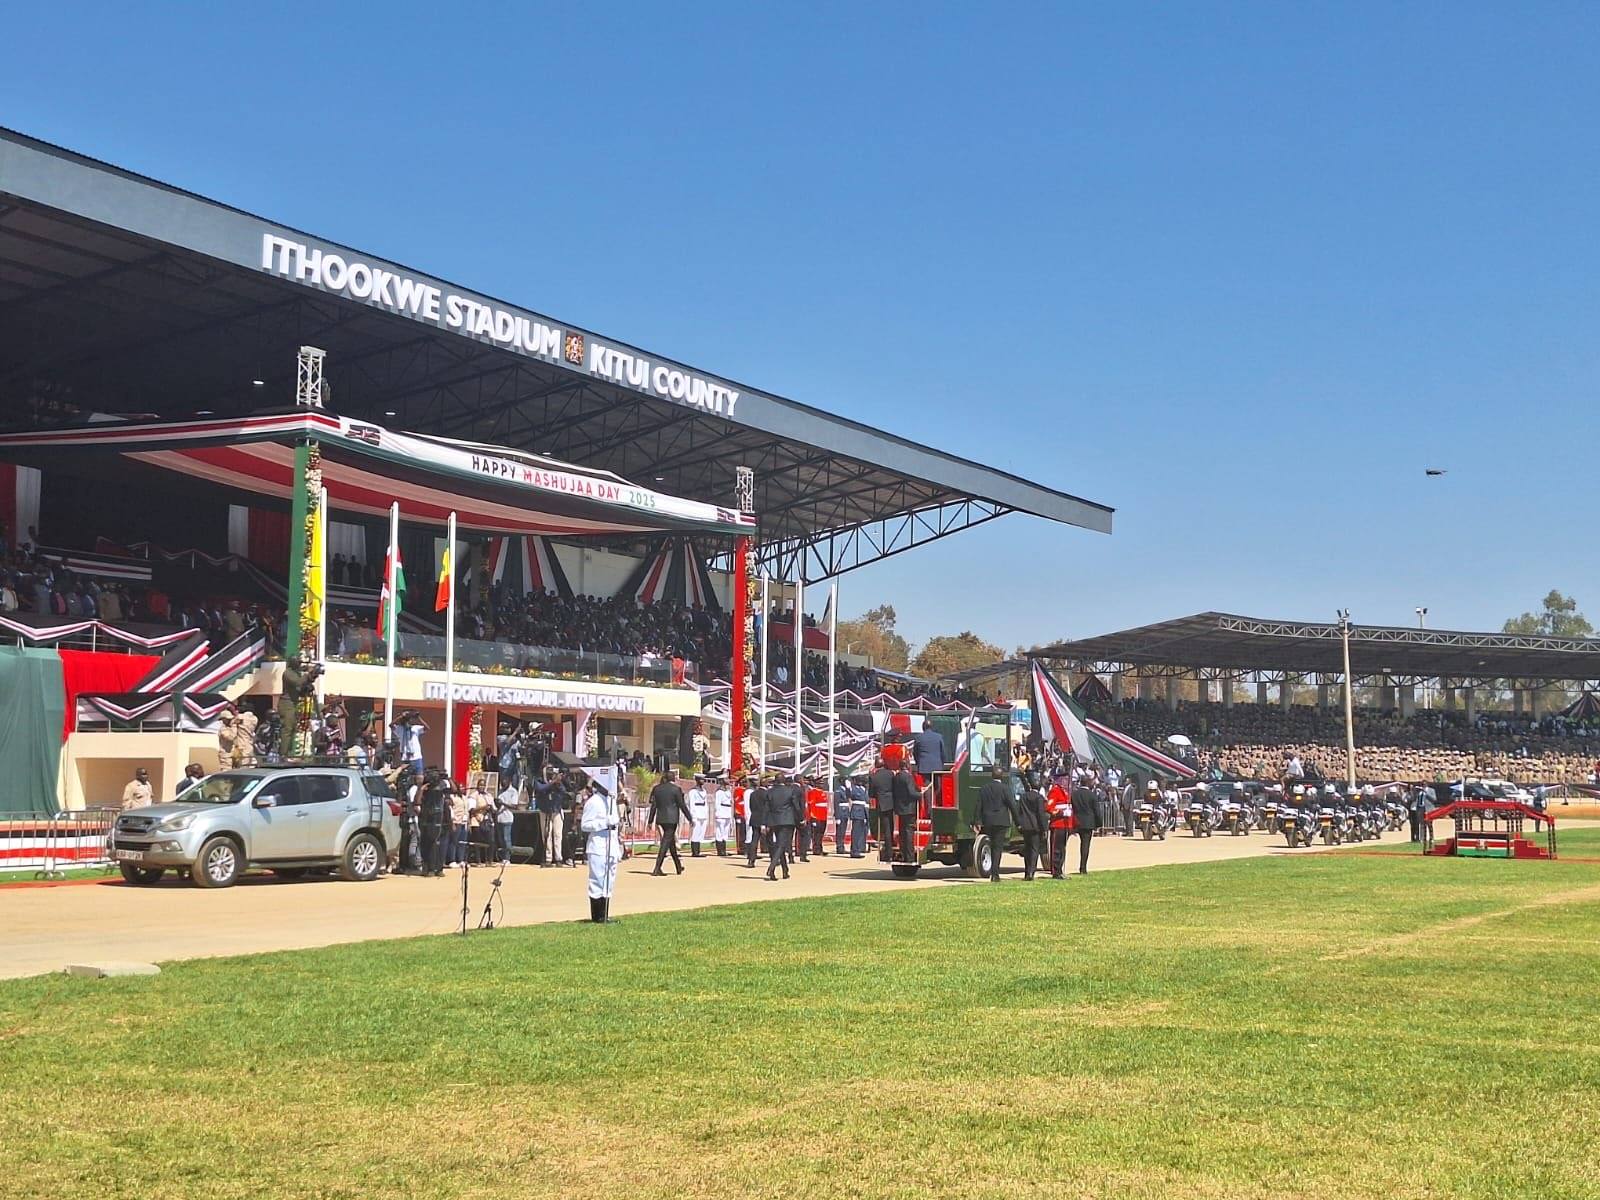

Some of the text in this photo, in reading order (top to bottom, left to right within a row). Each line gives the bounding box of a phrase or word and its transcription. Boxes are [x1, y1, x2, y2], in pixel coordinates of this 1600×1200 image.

[262, 233, 739, 416] ITHOOKWE STADIUM KITUI COUNTY
[472, 456, 656, 508] HAPPY MASHUJAA DAY 2025
[503, 688, 557, 707] STADIUM
[565, 693, 597, 708] KITUI
[598, 695, 644, 712] COUNTY
